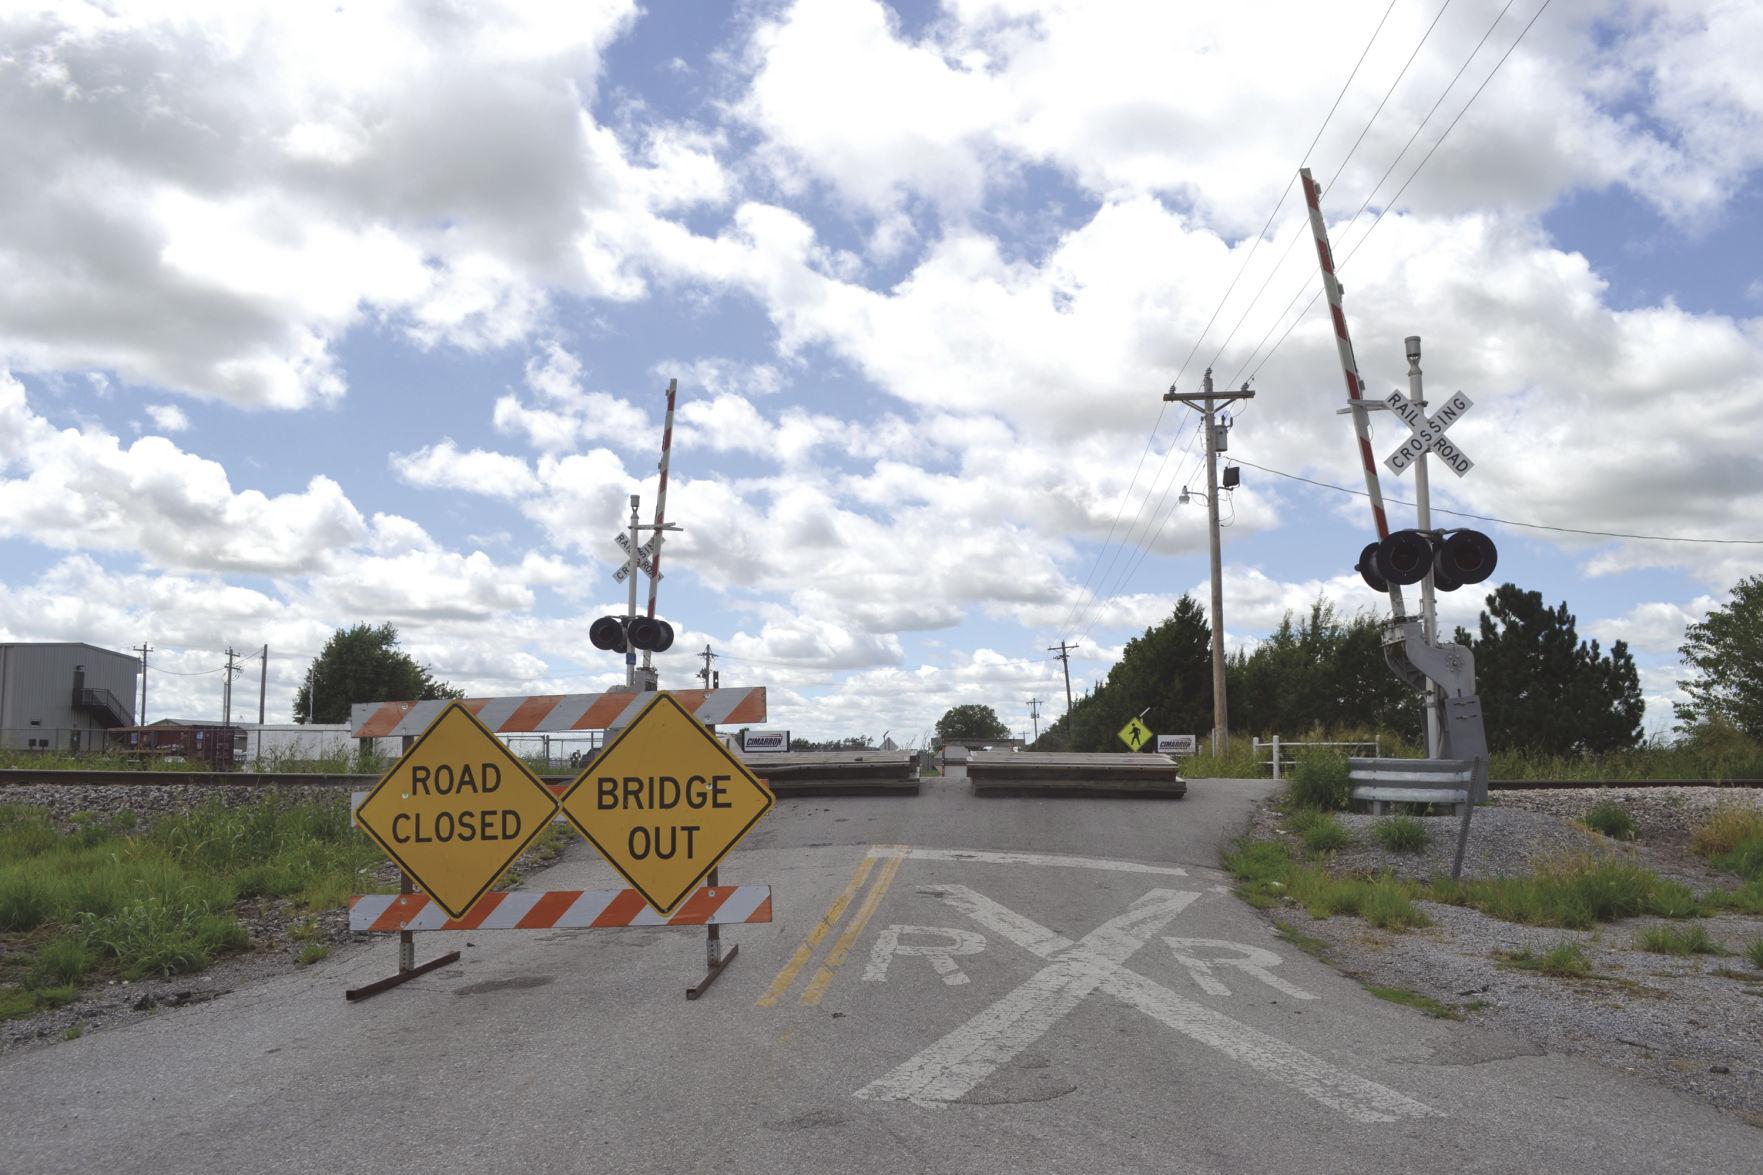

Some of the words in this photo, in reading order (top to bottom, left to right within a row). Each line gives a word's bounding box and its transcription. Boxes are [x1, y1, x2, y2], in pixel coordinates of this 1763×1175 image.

[1387, 392, 1419, 427] RAIL
[1433, 438, 1469, 472] ROAD
[1391, 398, 1466, 469] CROSSING
[746, 736, 783, 747] CIMARRON
[411, 762, 502, 796] ROAD
[597, 774, 732, 811] BRIDGE
[391, 809, 521, 844] CLOSED
[628, 825, 701, 860] OUT
